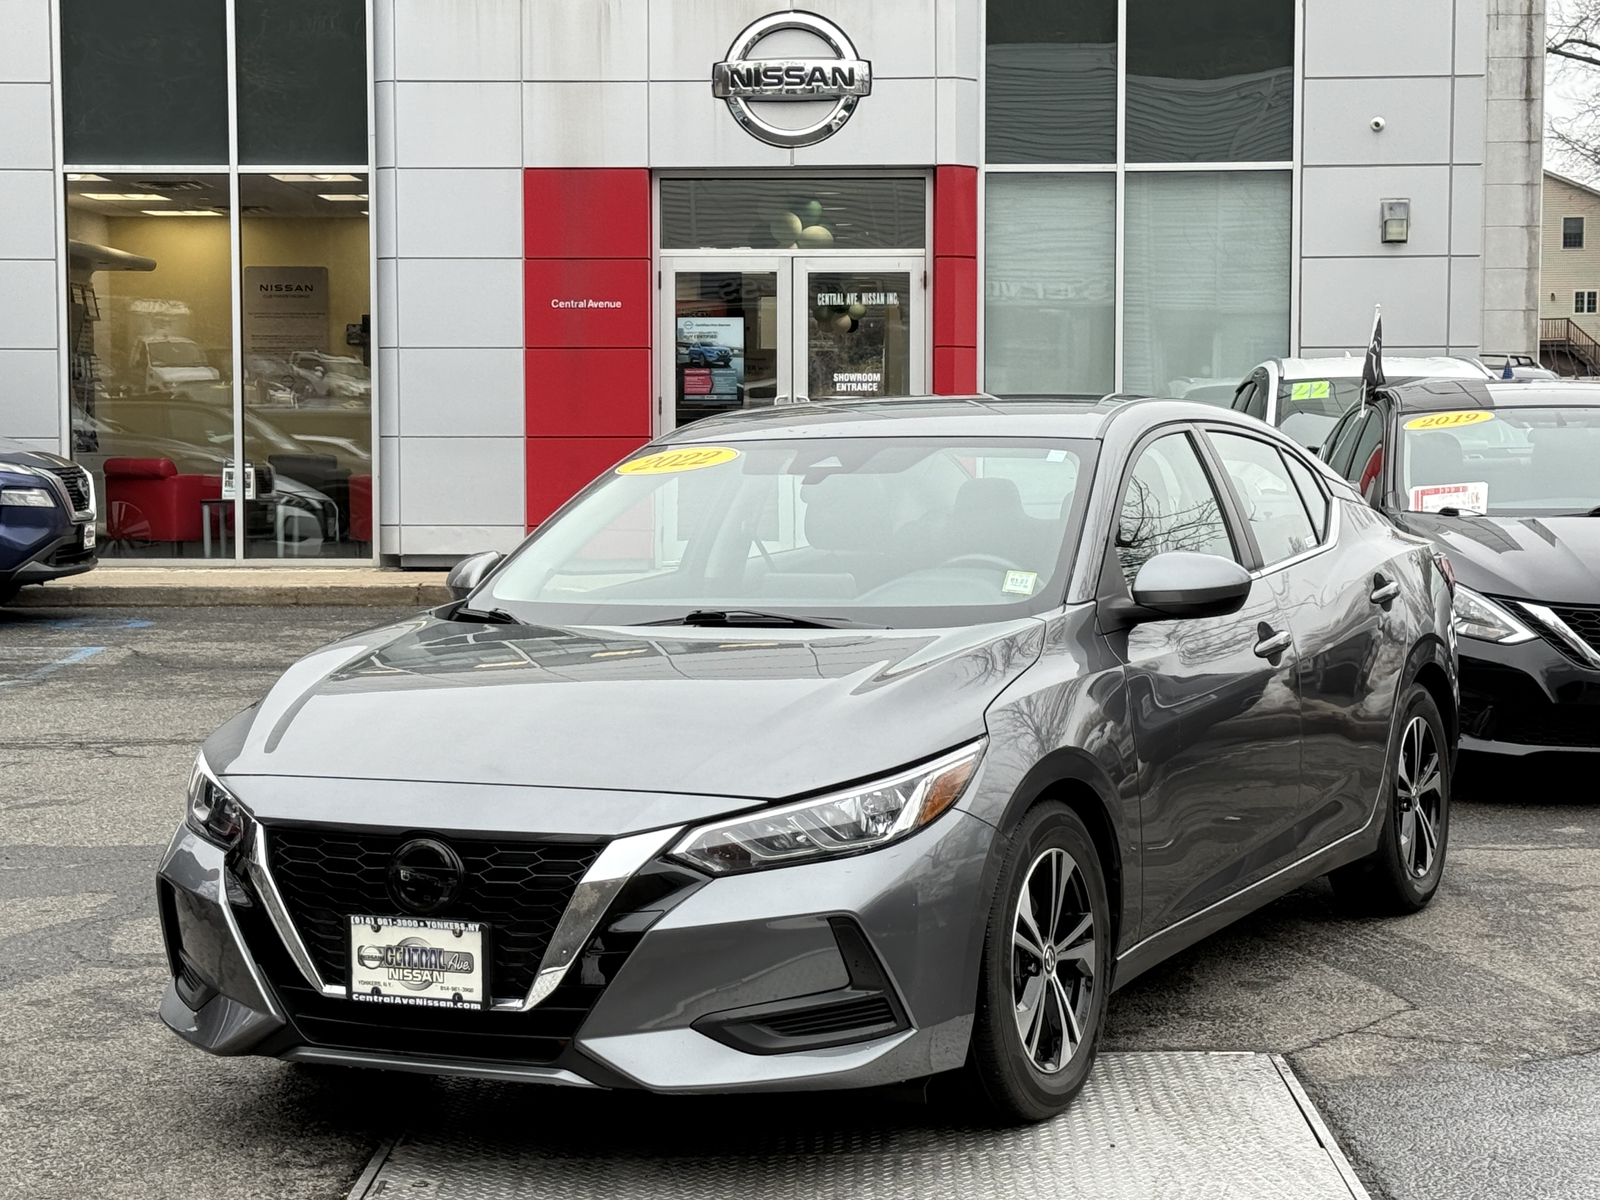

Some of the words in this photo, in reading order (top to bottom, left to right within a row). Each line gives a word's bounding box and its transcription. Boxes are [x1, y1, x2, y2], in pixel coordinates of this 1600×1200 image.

[730, 66, 855, 89] NISSAN
[259, 284, 314, 292] NISSAN
[551, 299, 587, 309] Central
[587, 299, 622, 309] Avenue
[817, 293, 845, 306] CENTRAL
[847, 293, 860, 305] AVE.
[861, 293, 885, 305] NISSAN
[833, 373, 881, 382] SHOWROOM
[836, 383, 878, 392] ENTRANCE
[1420, 412, 1480, 428] 2019
[630, 450, 723, 471] 2022
[385, 945, 445, 971] CENTRAL
[447, 953, 472, 971] Ave.
[388, 967, 445, 984] NISSAN
